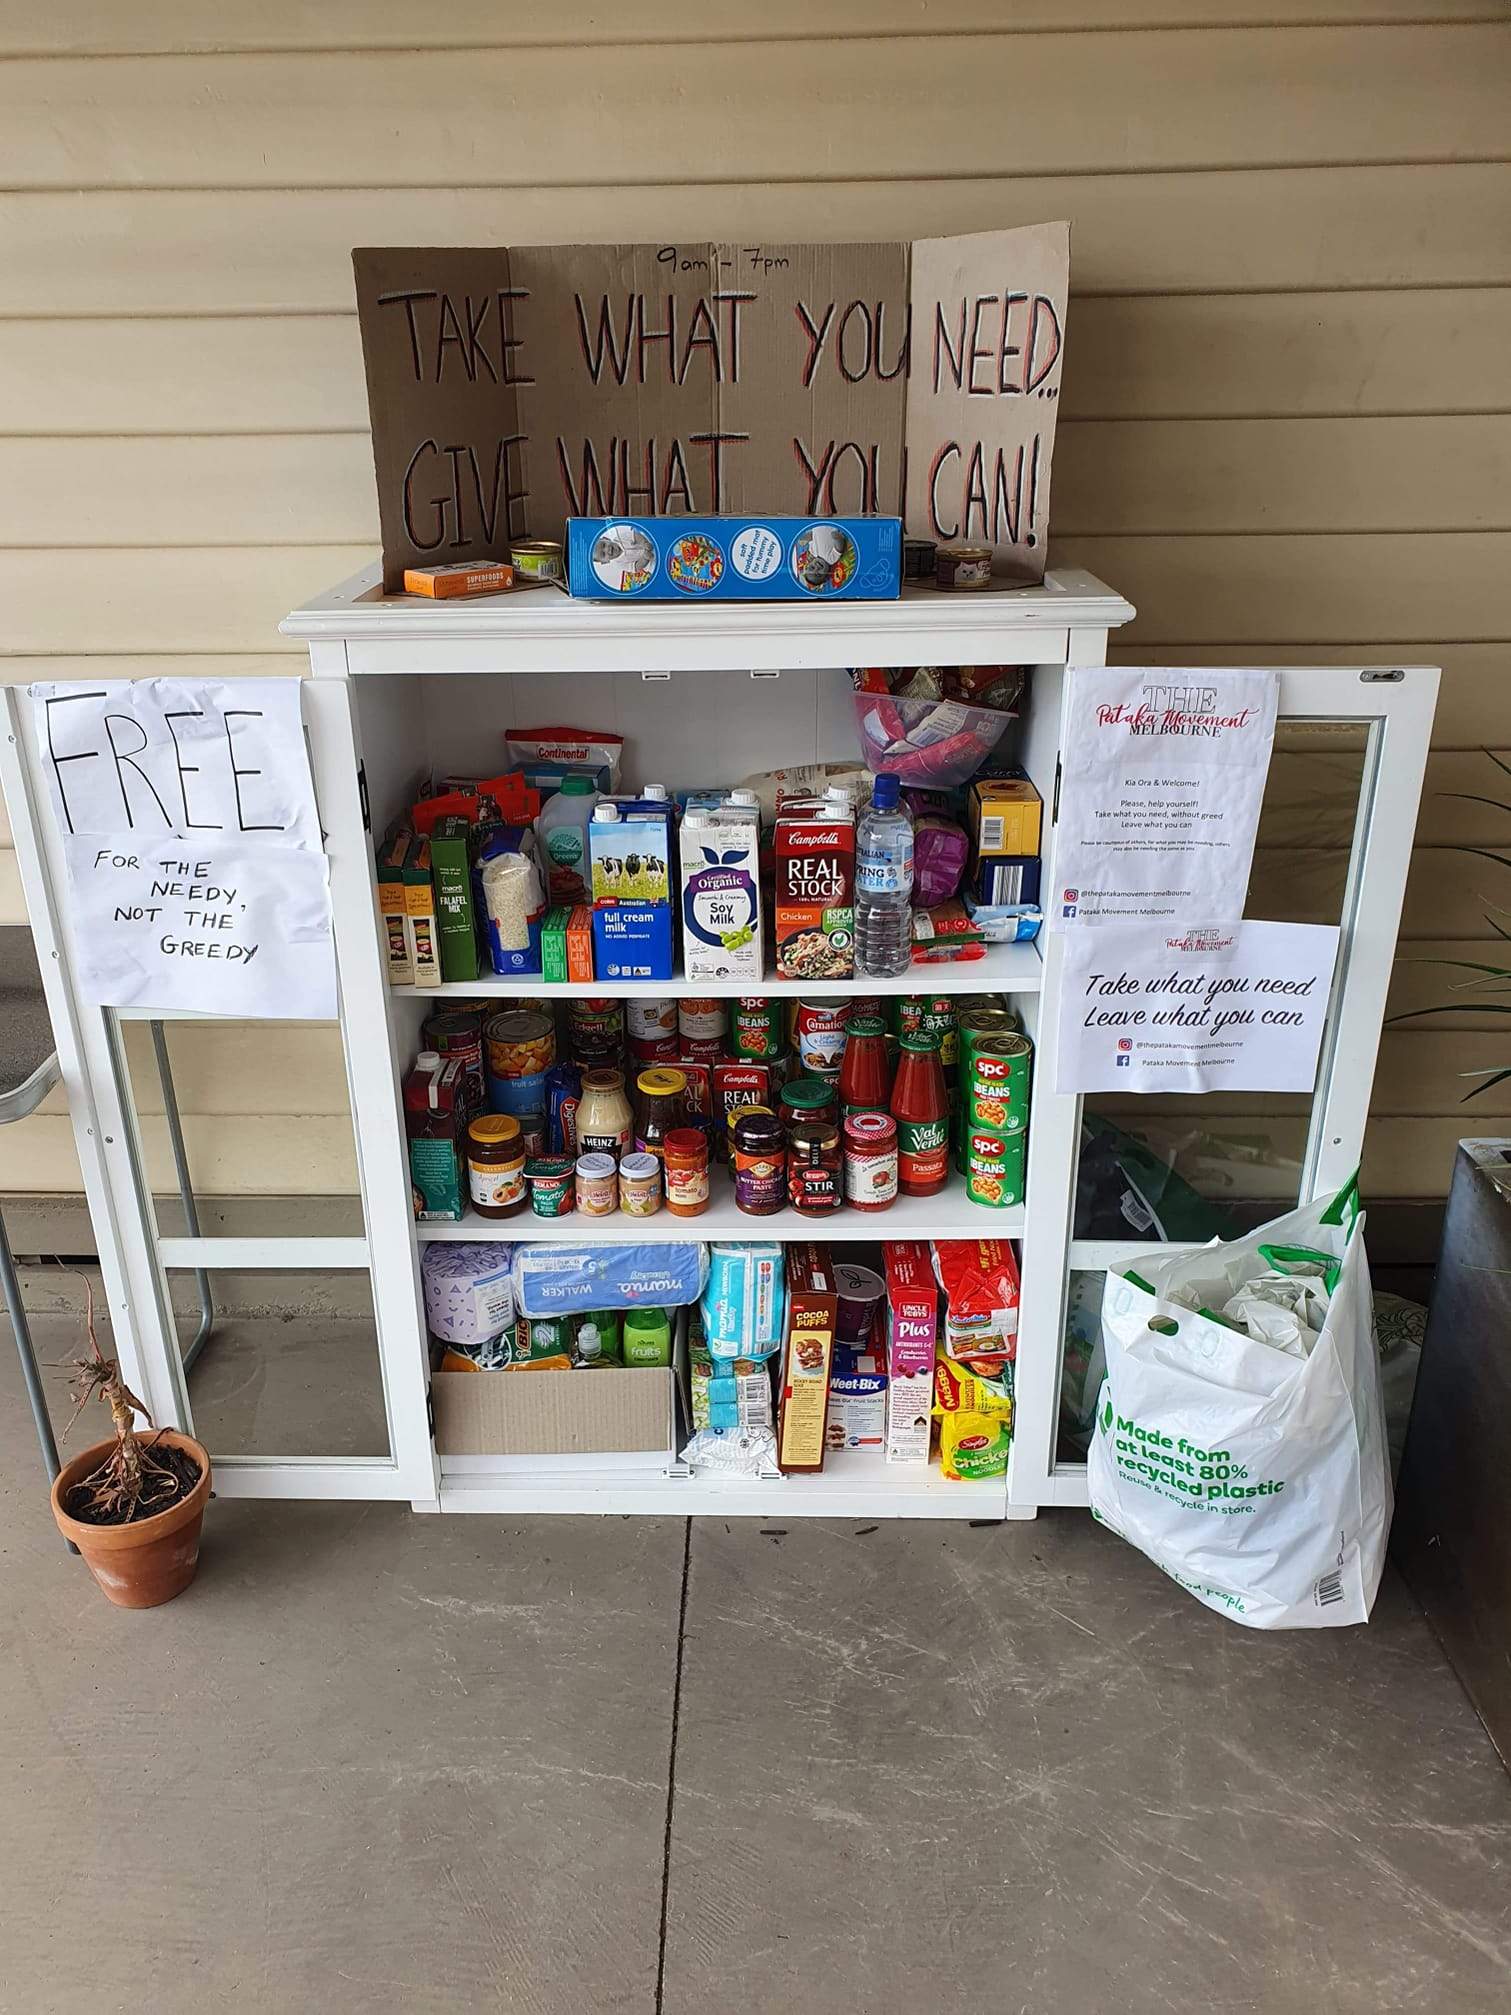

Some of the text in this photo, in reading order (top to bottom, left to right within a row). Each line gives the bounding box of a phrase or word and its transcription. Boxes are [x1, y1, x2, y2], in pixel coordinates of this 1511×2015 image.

[656, 246, 708, 272] 9am
[750, 249, 790, 272] 7pm
[379, 287, 535, 388] TAKE
[574, 290, 758, 387] WHAT
[795, 299, 911, 388] YOU
[402, 433, 532, 551] GIVE
[556, 431, 750, 518] WHAT
[926, 434, 1042, 551] CAN!
[466, 571, 504, 583] SUPERFOODS
[1143, 685, 1217, 714] THE
[1096, 703, 1260, 730] Pataka Movement
[1129, 723, 1222, 738] MELBOURNE
[538, 747, 589, 760] Continental
[46, 691, 285, 836] FREE
[1124, 779, 1200, 788] Kia Ora & Welcome!
[1120, 800, 1199, 808] Please, help yourself!
[1148, 811, 1169, 819] need,
[1171, 811, 1200, 819] without
[1201, 812, 1224, 821] greed
[1143, 821, 1162, 829] what
[1164, 822, 1178, 830] you
[788, 831, 841, 847] Campbell's
[94, 850, 212, 878] FOR THE
[788, 859, 844, 880] REAL
[698, 877, 743, 890] Organic
[788, 880, 844, 896] STOCK
[150, 881, 246, 912] NEEDY,
[440, 896, 467, 905] FALAFEL
[448, 904, 461, 913] MIX
[710, 902, 734, 917] Soy
[826, 909, 853, 920] RSPCA
[1079, 907, 1175, 916] Pataka Movement Melbourne
[114, 907, 234, 930] NOT THE
[604, 912, 654, 923] full cream
[709, 914, 736, 925] Milk
[780, 912, 813, 921] Chicken
[605, 923, 627, 933] milk
[1186, 929, 1220, 941] THE
[160, 934, 259, 964] GREEDY
[1085, 971, 1317, 1006] Take what you need
[740, 997, 764, 1013] spc
[742, 1016, 770, 1027] BEANS
[1084, 1003, 1305, 1037] Leave what you can
[977, 1062, 1005, 1077] spc
[1142, 1057, 1235, 1068] Pataka Movement Melbourne
[511, 1080, 526, 1089] fruit
[723, 1073, 759, 1084] Campbell's
[975, 1083, 1011, 1097] BEANS
[724, 1091, 760, 1105] REAL
[911, 1123, 937, 1142] Val
[586, 1138, 614, 1147] HEINZ
[973, 1139, 1000, 1154] spc
[912, 1162, 943, 1172] Passata
[971, 1159, 1006, 1174] BEANS
[805, 1181, 834, 1192] STIR
[532, 1190, 565, 1201] Tomato
[586, 1260, 599, 1273] 5
[541, 1278, 683, 1298] WALKER mamia
[795, 1310, 830, 1320] COCOA
[902, 1304, 928, 1312] UNCLE
[718, 1298, 729, 1340] mamia
[796, 1318, 828, 1328] PUFFS
[517, 1320, 529, 1349] BIC
[898, 1321, 931, 1338] Plus
[631, 1346, 661, 1357] fruits
[829, 1377, 881, 1390] Weet-Bix
[1116, 1415, 1231, 1463] Made from
[954, 1448, 1008, 1469] Chicke
[1116, 1439, 1248, 1480] at least 80%
[1116, 1455, 1286, 1500] recycled plastic
[1118, 1470, 1257, 1515] Reuse & recycle in store.
[1206, 1587, 1246, 1614] people
